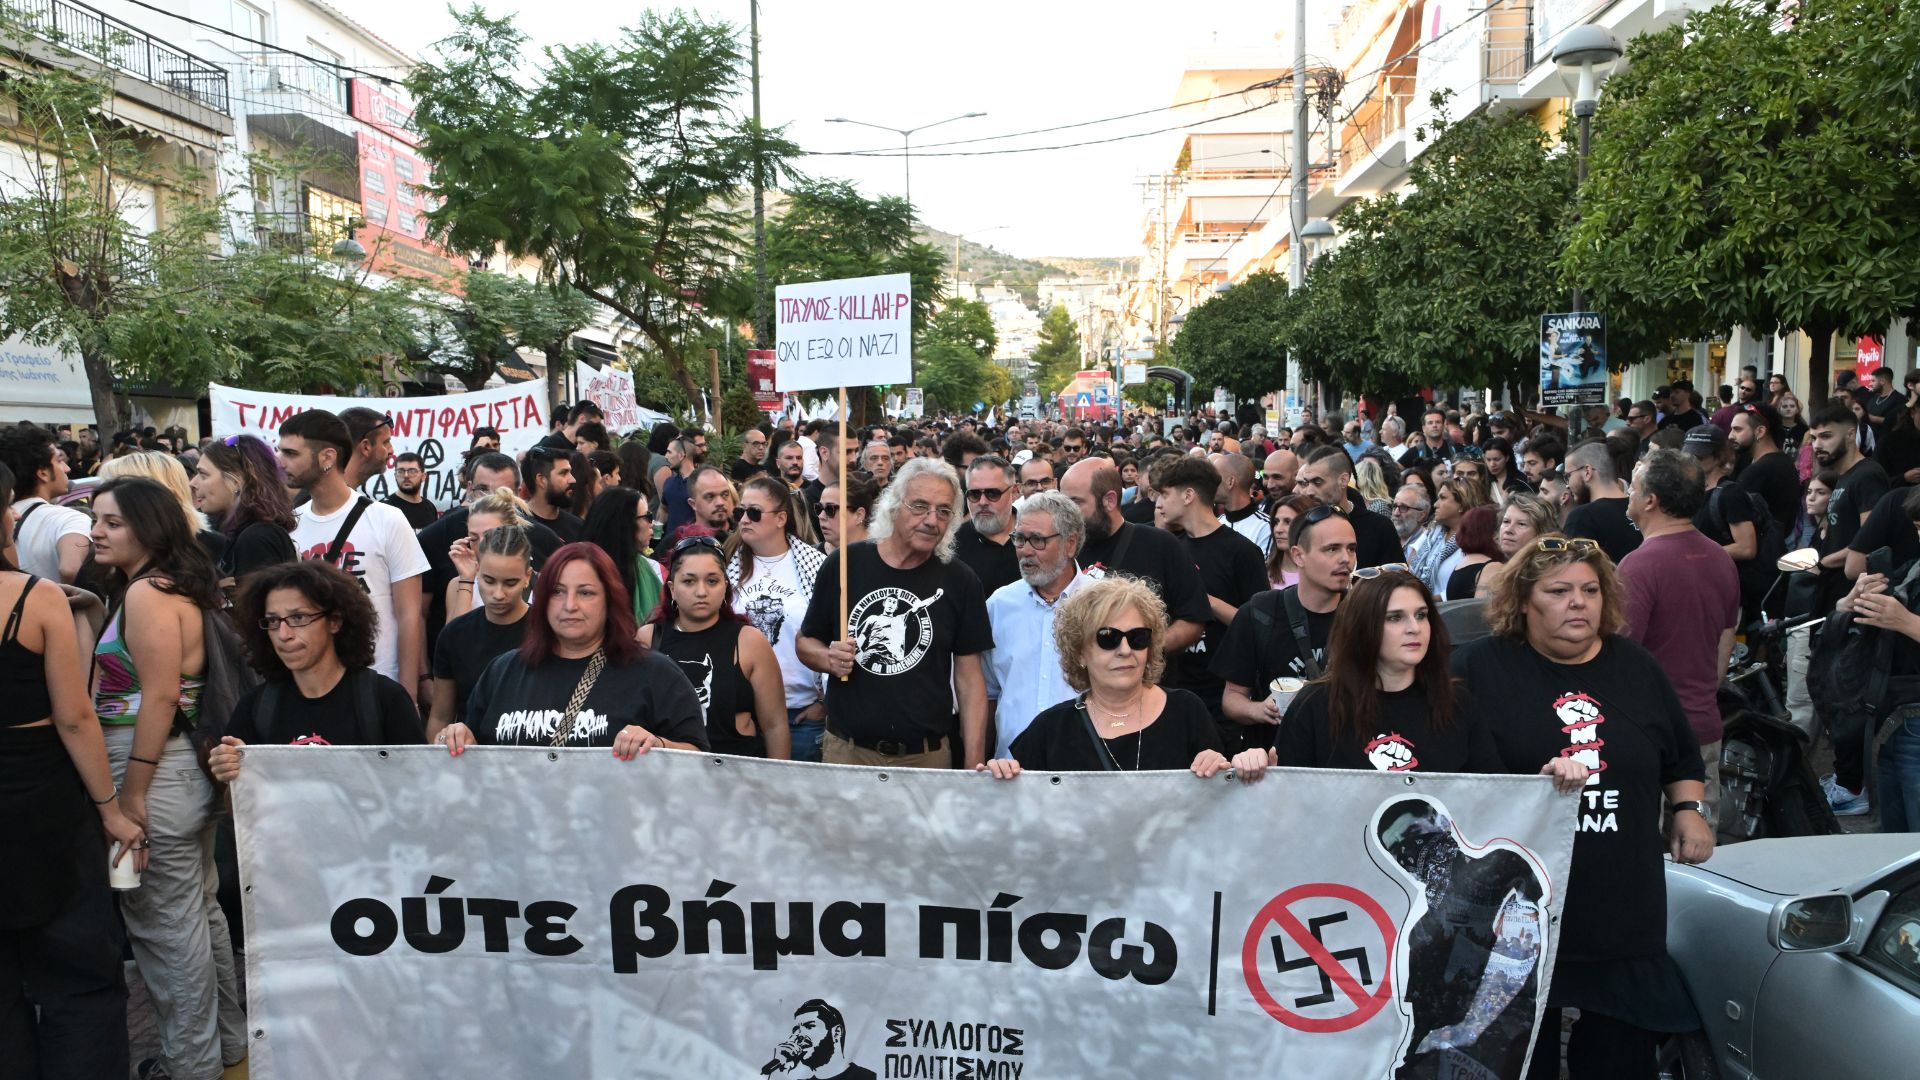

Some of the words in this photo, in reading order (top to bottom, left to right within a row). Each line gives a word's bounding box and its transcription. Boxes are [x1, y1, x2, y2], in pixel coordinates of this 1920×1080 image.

[1548, 317, 1600, 330] SANKARA
[777, 340, 800, 362] ΟΧΙ
[807, 338, 834, 361] ΕΞΩ
[838, 336, 853, 358] ΟΙ
[859, 332, 898, 358] ΝΑΖΙ
[899, 592, 917, 604] ΠΟΤΕ
[1582, 789, 1620, 810] ΤΕ
[330, 874, 584, 956] ούτε
[609, 878, 887, 974] βήμα
[918, 891, 1179, 986] πίσω
[885, 1018, 1025, 1056] ΣΥΛΛΟΓΟΣ
[884, 1053, 1025, 1080] ΠΟΛΙΤΙΣΜΟΥ
